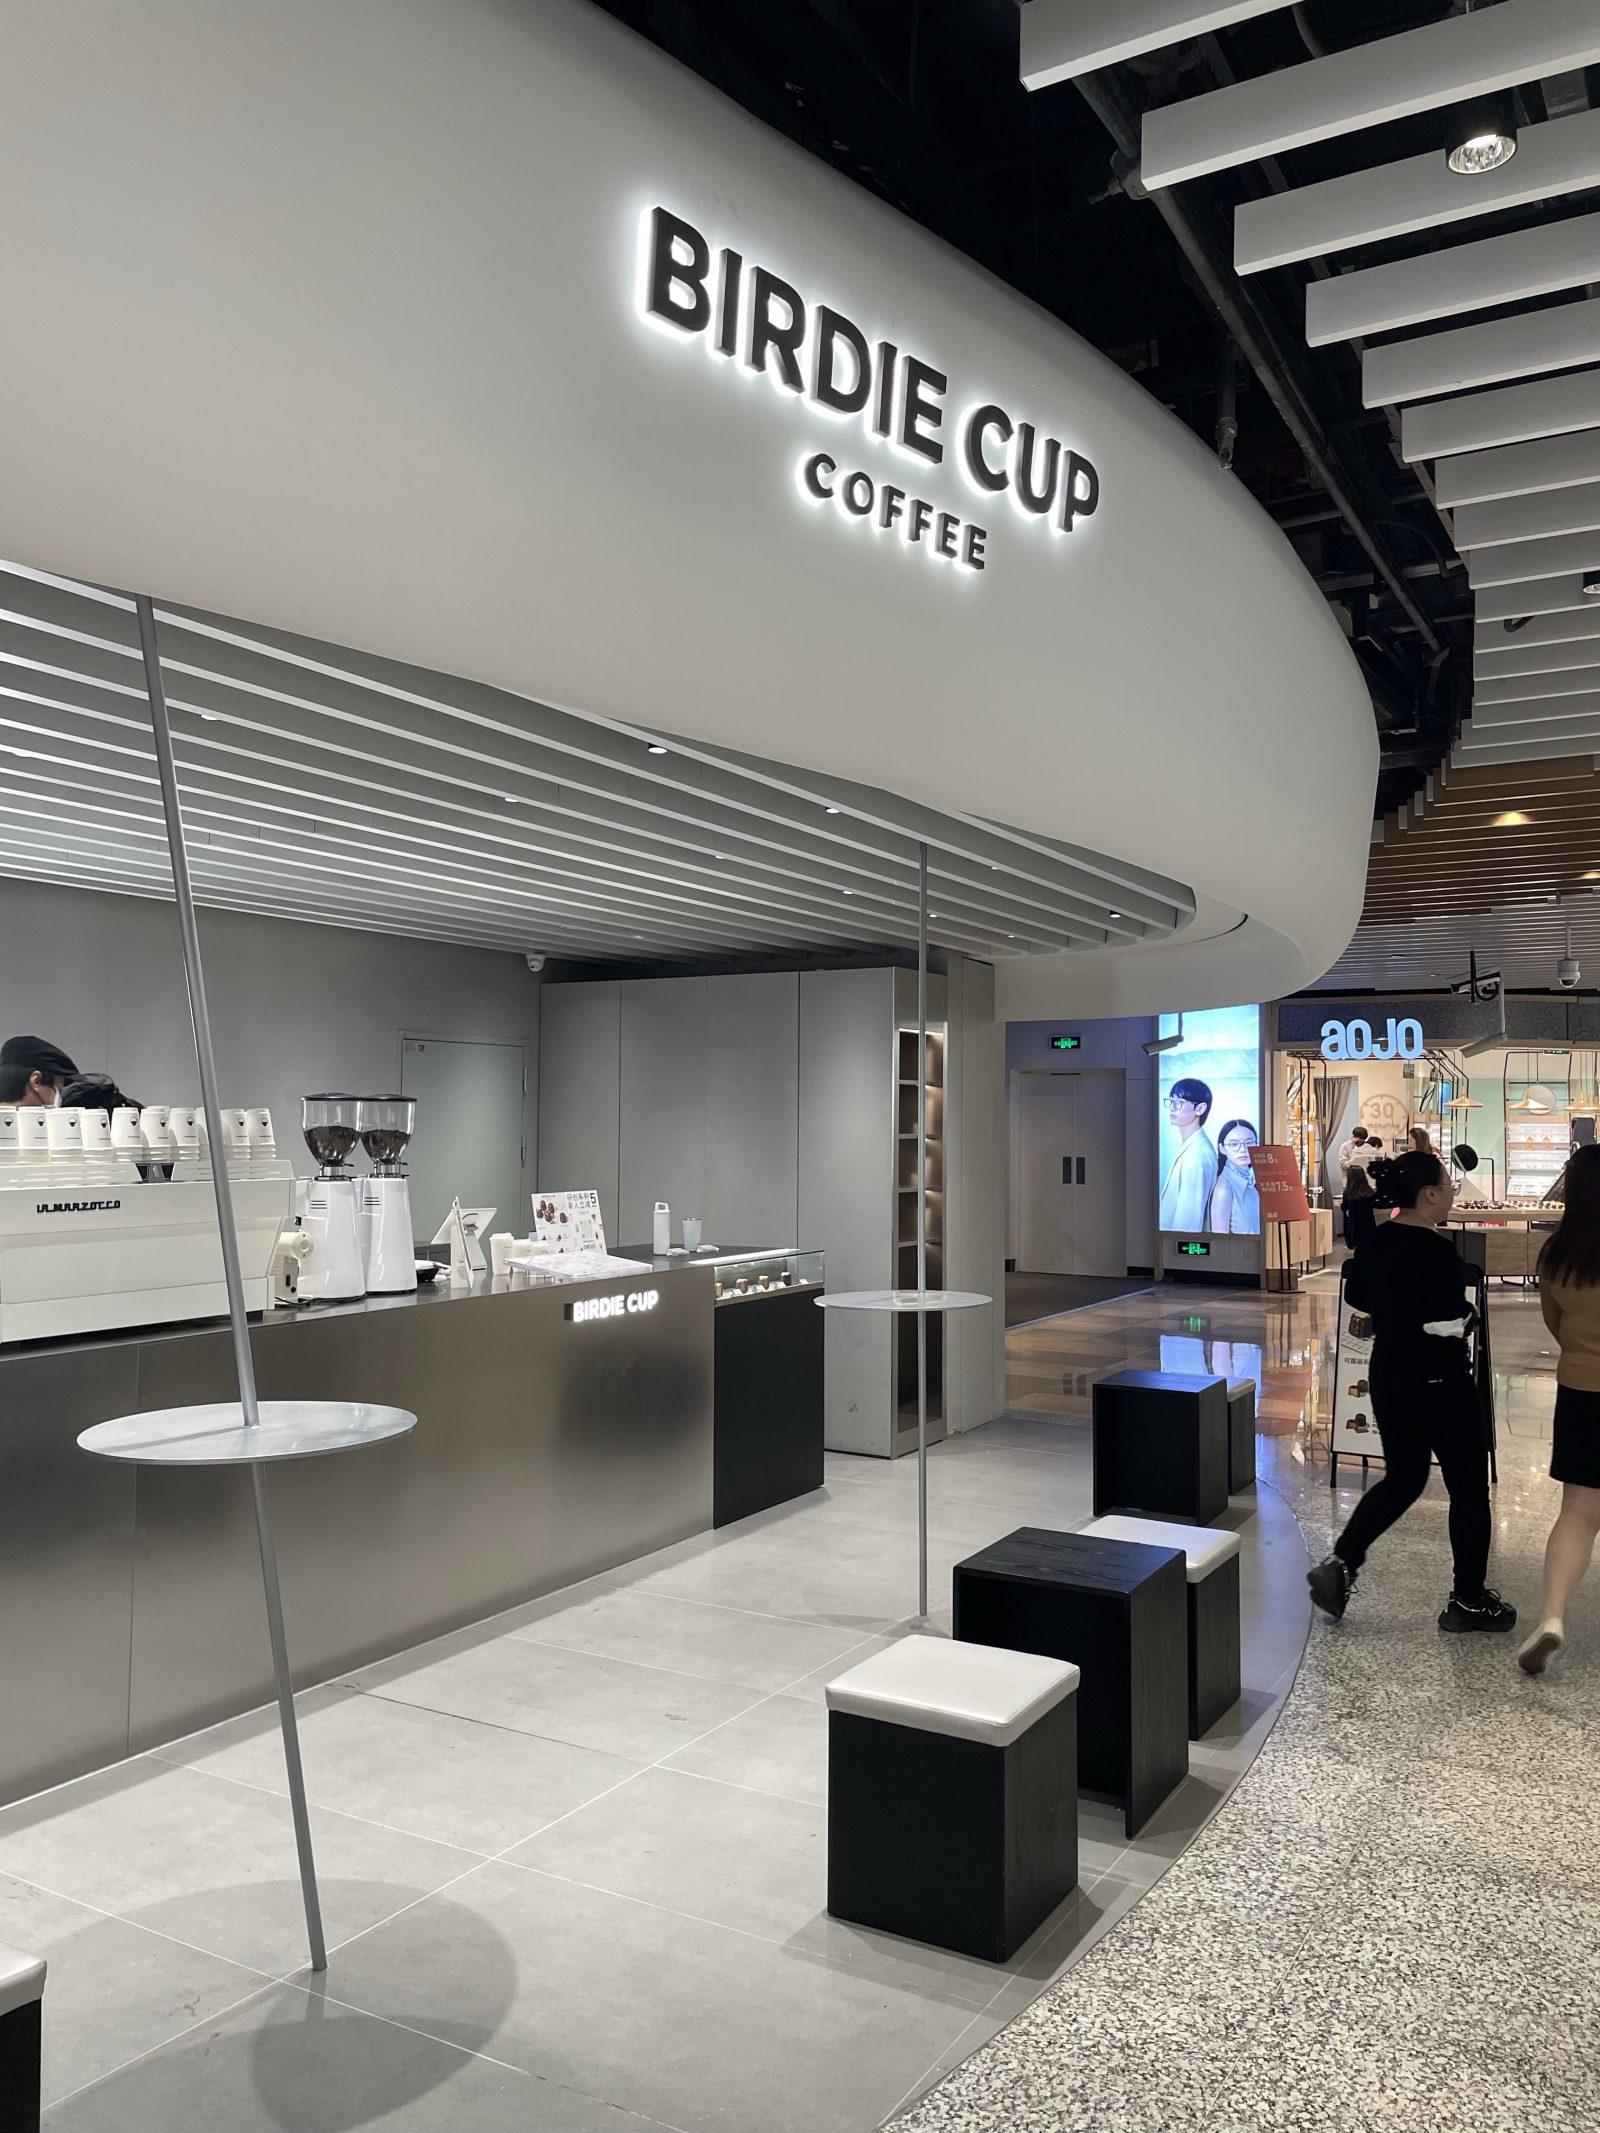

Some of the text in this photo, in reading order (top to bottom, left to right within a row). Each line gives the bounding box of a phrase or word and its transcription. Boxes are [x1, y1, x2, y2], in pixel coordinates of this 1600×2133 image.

[646, 206, 1100, 533] BIRDIE CUP
[803, 453, 987, 571] COFFEE
[1370, 1102, 1394, 1118] 30
[573, 1290, 659, 1322] BIRDIE CUP
